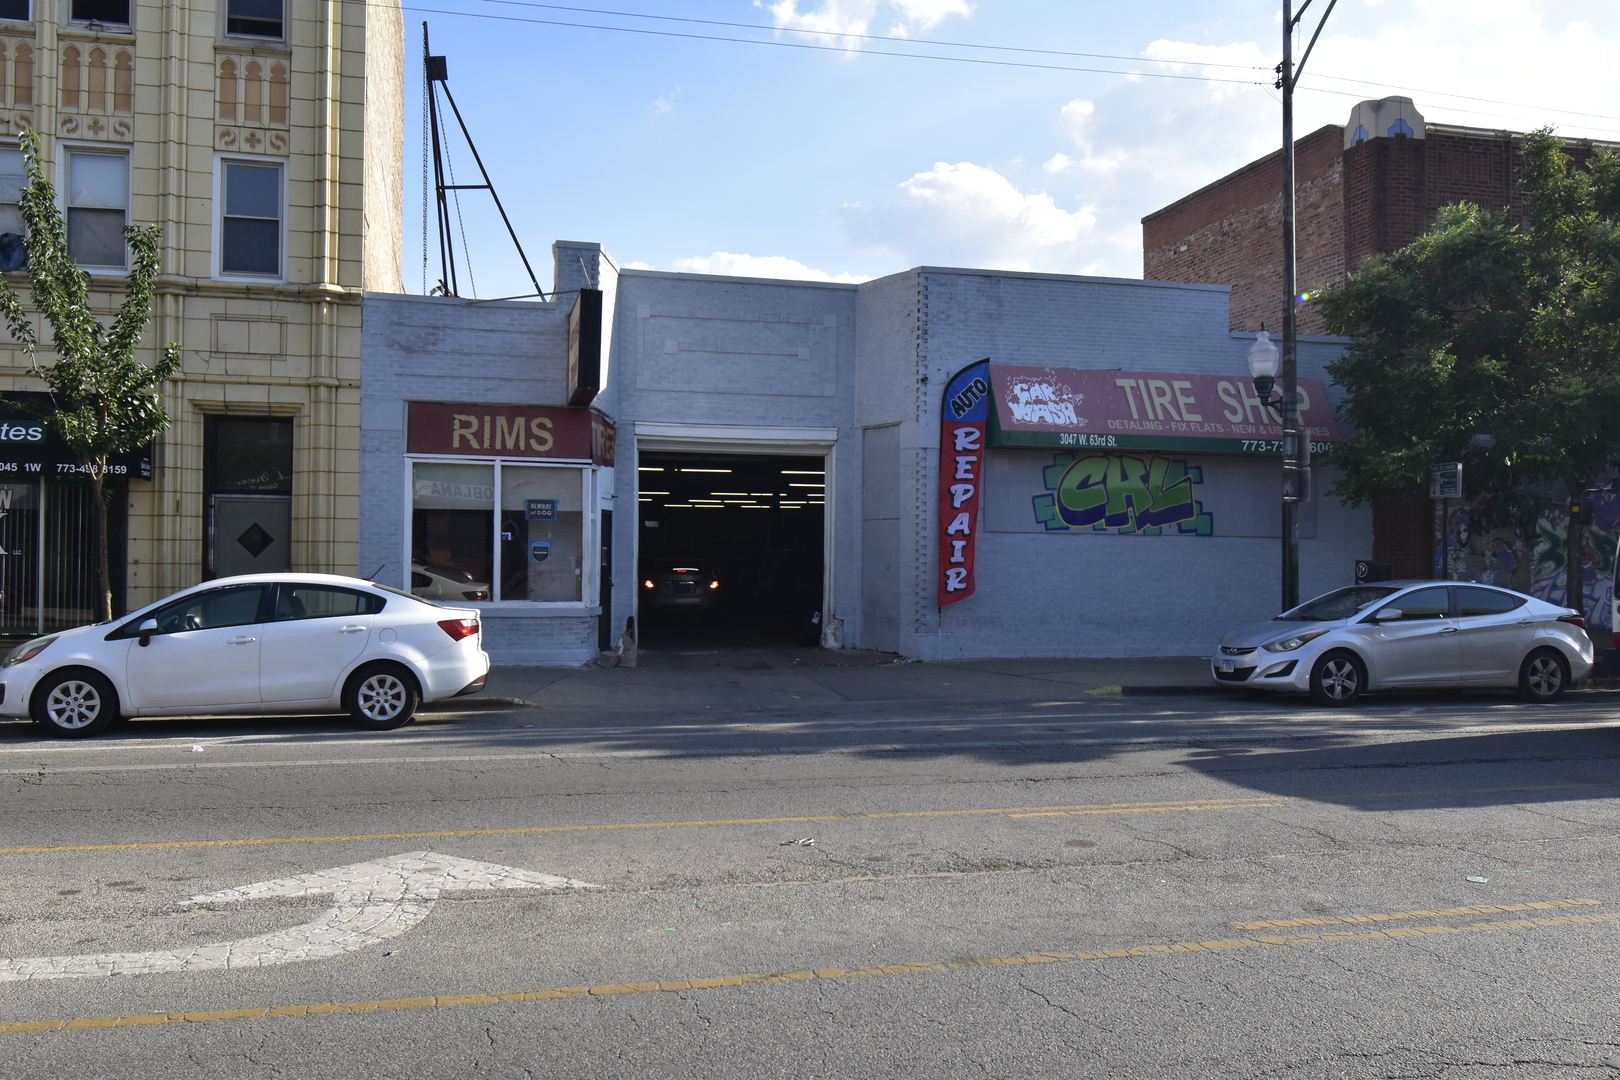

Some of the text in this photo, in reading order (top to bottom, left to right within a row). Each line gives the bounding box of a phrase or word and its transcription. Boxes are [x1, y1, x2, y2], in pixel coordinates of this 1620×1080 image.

[951, 377, 988, 419] AUTO
[1013, 383, 1059, 404] CAR
[1115, 378, 1311, 426] TIRE SHOP
[1008, 401, 1078, 425] WASH
[0, 422, 42, 442] tes
[452, 414, 553, 452] RIMS
[1108, 419, 1163, 431] DETALING
[1171, 422, 1188, 432] FIX
[1190, 422, 1224, 433] FLATS
[1232, 424, 1256, 435] NEW
[1259, 425, 1267, 435] &
[1060, 433, 1117, 447] 3047 W. 63rd St.
[0, 462, 127, 475] 045 1W 773-4988159
[945, 426, 981, 592] REPAIR
